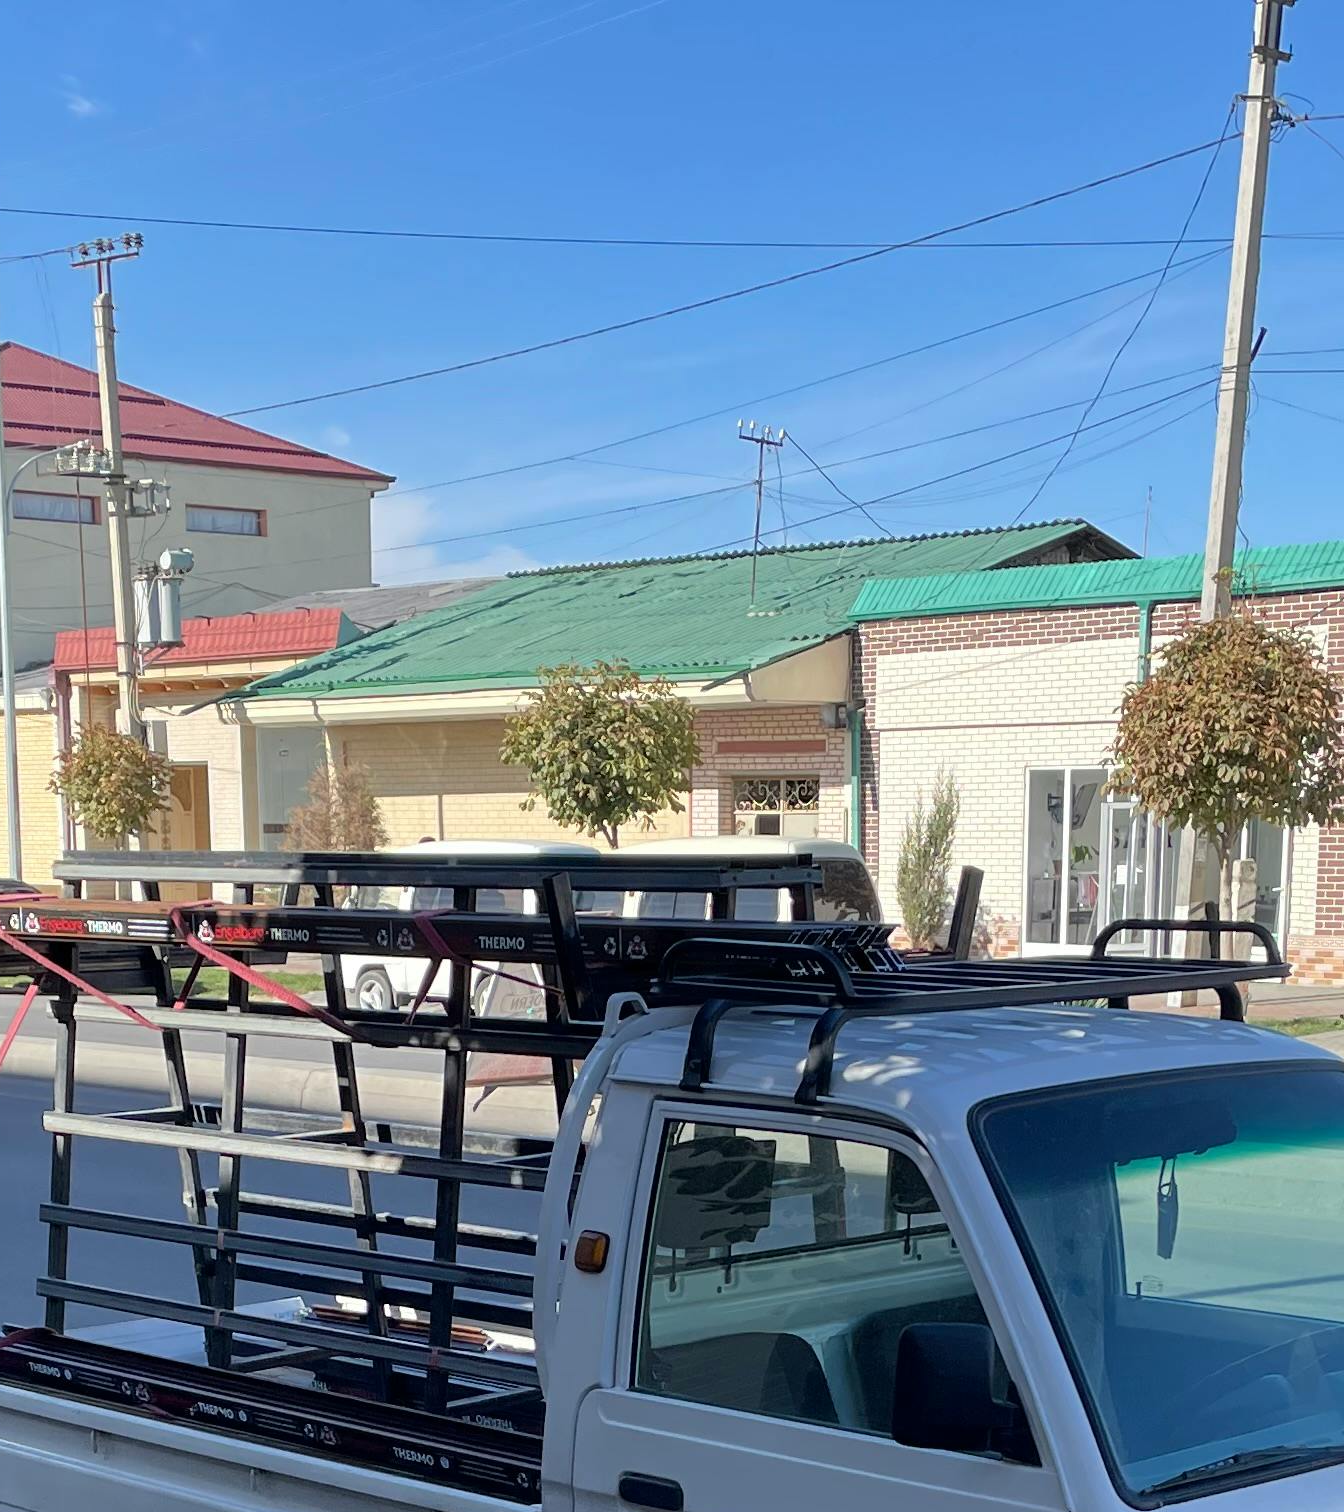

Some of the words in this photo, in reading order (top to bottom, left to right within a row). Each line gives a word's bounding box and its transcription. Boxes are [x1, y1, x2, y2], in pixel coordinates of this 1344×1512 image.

[87, 919, 123, 934] THERMO
[270, 927, 309, 942] THERMO
[478, 935, 525, 950] THERMO
[392, 1446, 435, 1466] THERMO
